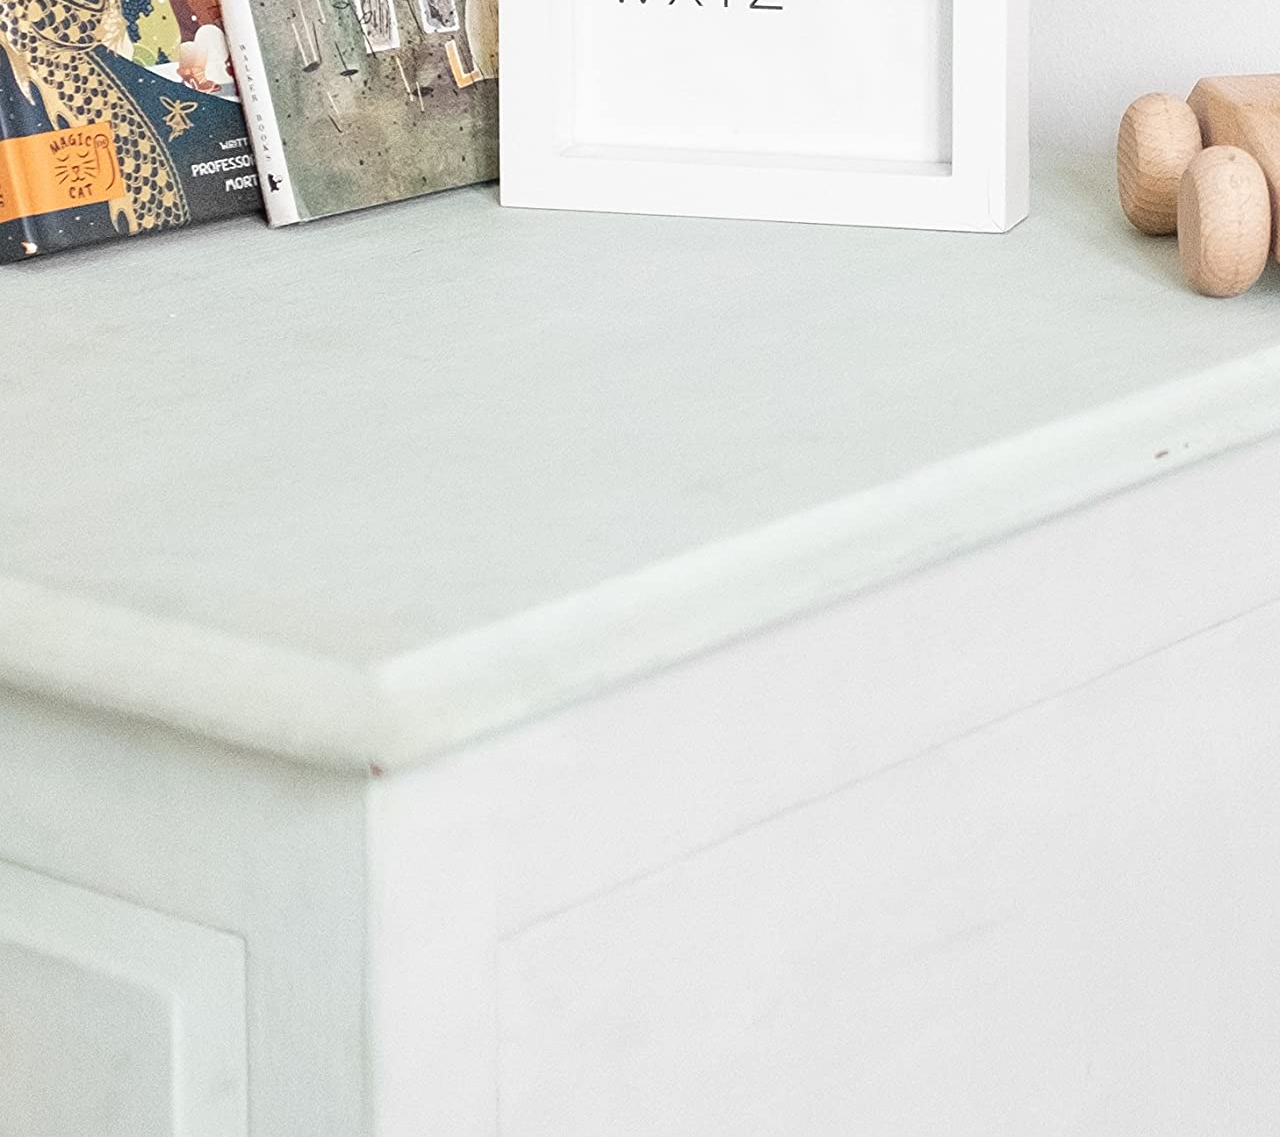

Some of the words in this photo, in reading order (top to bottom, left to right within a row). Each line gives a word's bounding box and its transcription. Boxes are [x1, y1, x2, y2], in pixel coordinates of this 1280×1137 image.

[49, 132, 93, 155] MAGIC
[219, 137, 248, 150] WRITT
[256, 114, 272, 162] BOOKS
[69, 183, 94, 199] CAT
[225, 173, 259, 192] MORT
